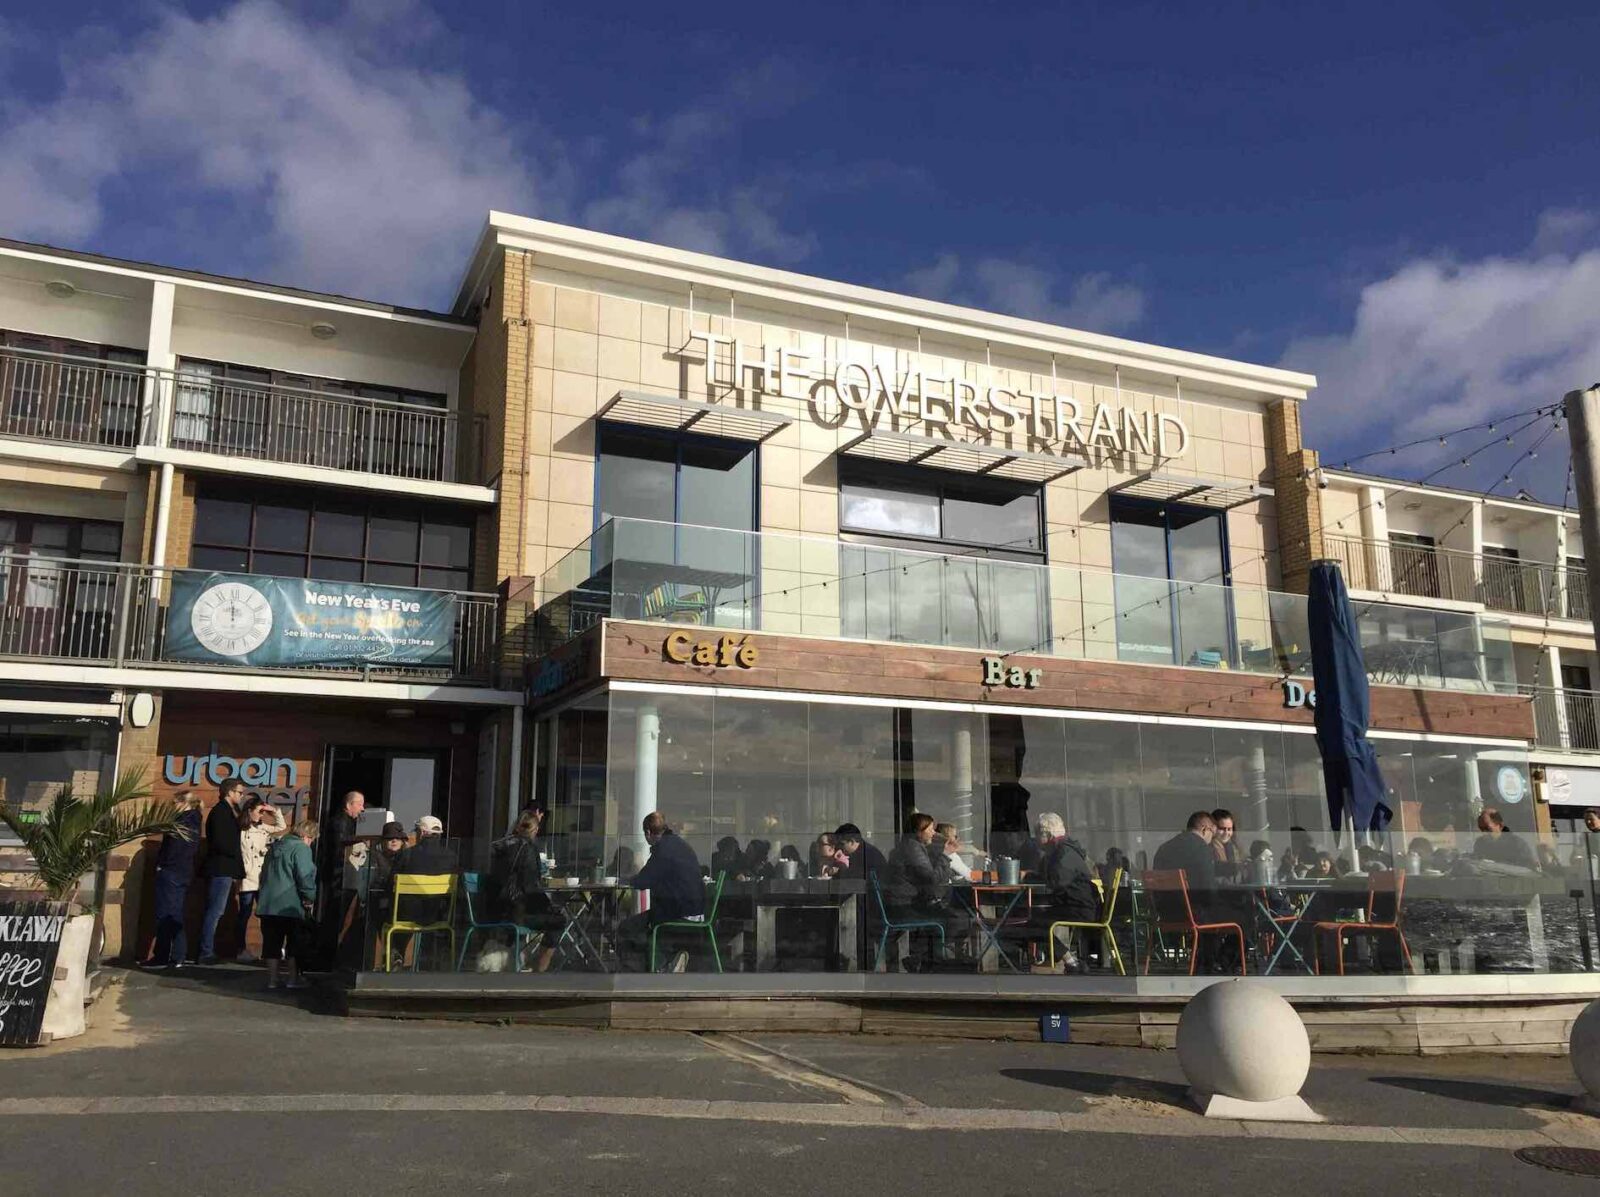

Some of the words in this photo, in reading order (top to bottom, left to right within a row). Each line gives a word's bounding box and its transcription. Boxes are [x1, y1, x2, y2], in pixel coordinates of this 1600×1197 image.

[690, 330, 818, 398] THE
[835, 362, 1190, 460] OVERSTRAND
[305, 591, 343, 606] New
[344, 594, 390, 611] Year's
[391, 598, 420, 613] Eve
[300, 629, 308, 637] in
[309, 630, 323, 638] the
[324, 631, 342, 640] New
[343, 632, 360, 640] Year
[361, 634, 407, 646] overlooking
[408, 637, 421, 645] the
[664, 629, 760, 668] Café
[983, 656, 1043, 687] Bar
[163, 744, 298, 787] urban
